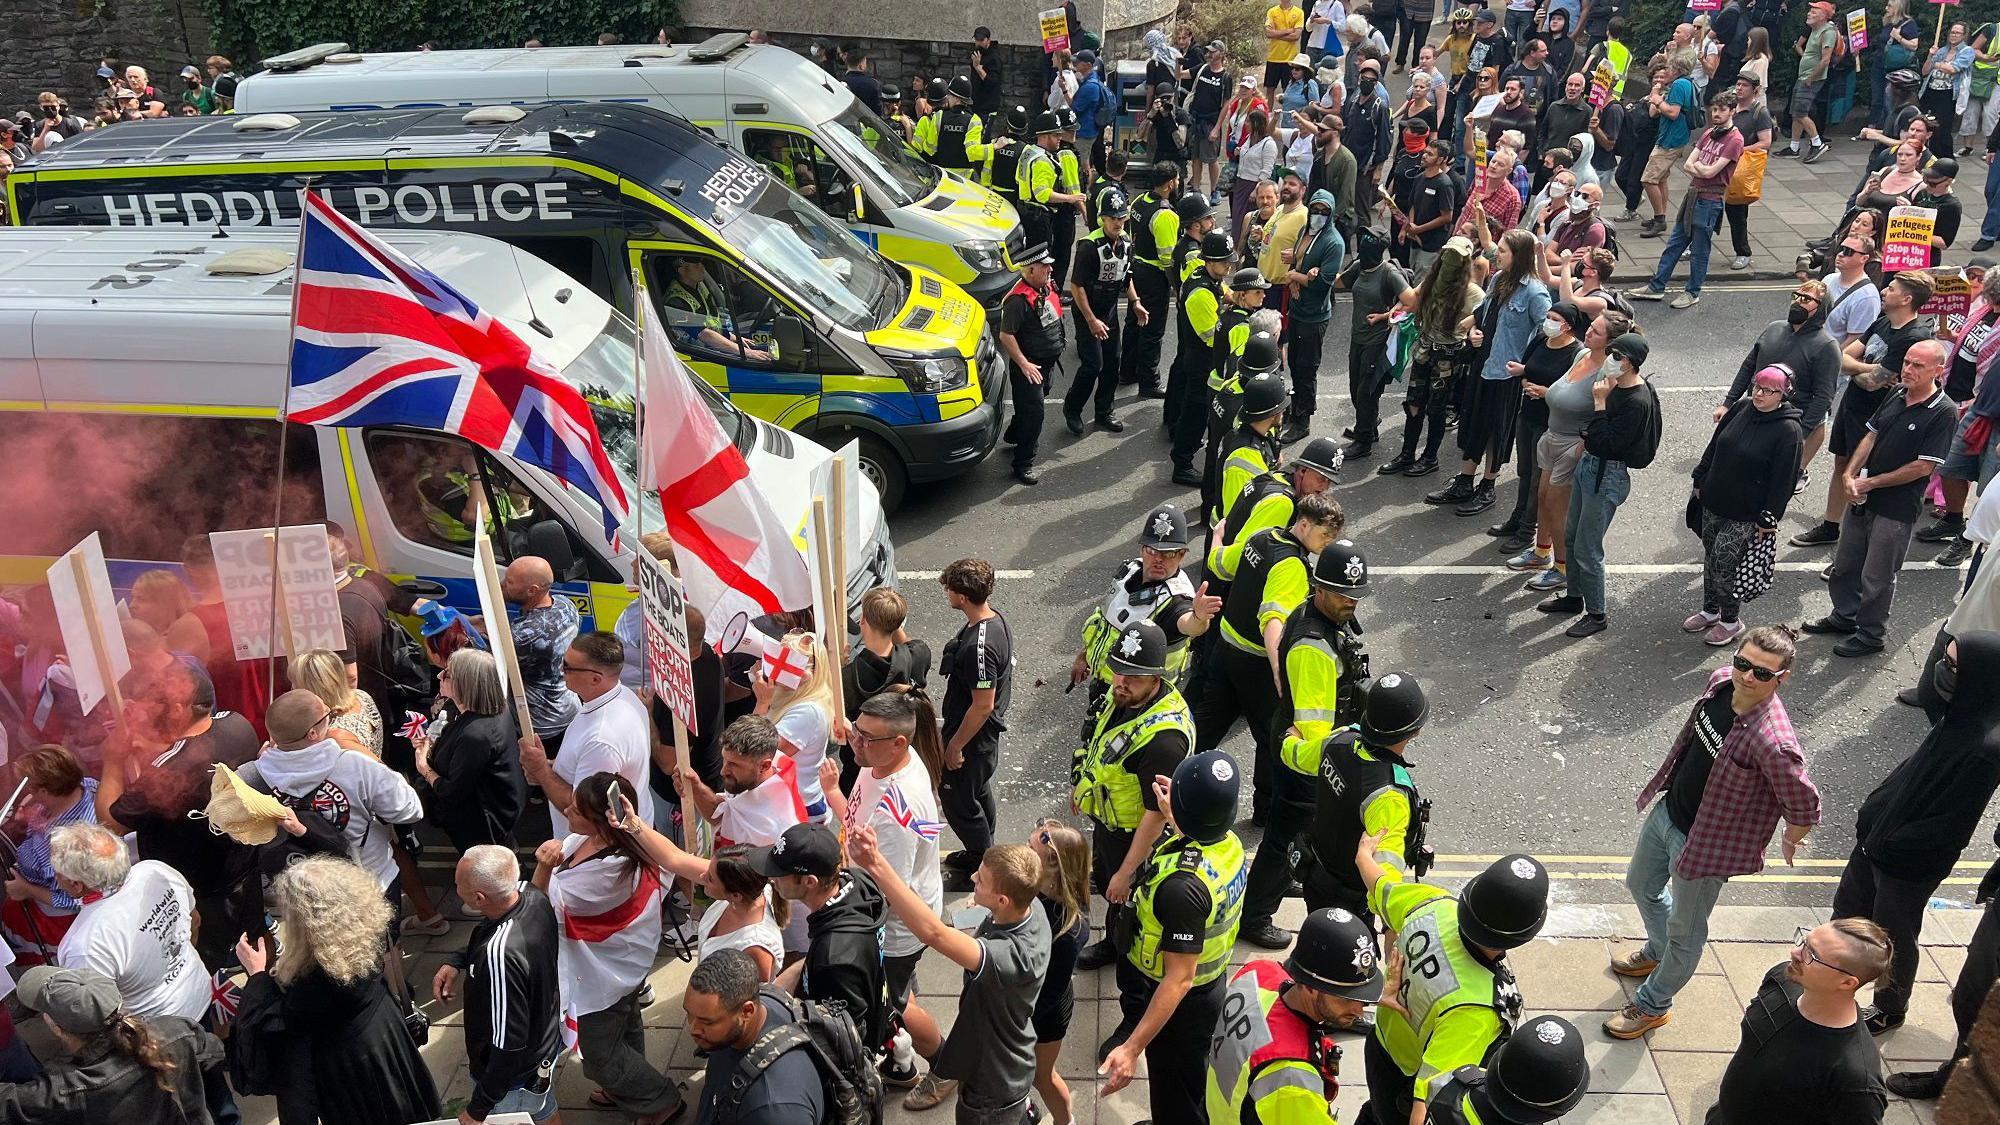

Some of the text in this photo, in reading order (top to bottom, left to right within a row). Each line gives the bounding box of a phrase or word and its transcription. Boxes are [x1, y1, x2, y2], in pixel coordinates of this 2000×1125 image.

[944, 124, 964, 133] POLICE
[698, 158, 748, 203] HEDDLU
[716, 167, 765, 214] POLICE
[354, 182, 574, 224] POLICE
[1889, 230, 1928, 242] welcome
[1890, 220, 1932, 232] Refugees
[1885, 255, 1924, 267] far right
[1887, 244, 1925, 255] Stop the
[1938, 302, 1965, 312] right
[639, 554, 683, 619] STOP
[643, 592, 687, 650] THE BOATS
[646, 622, 689, 677] DEPORT
[647, 643, 693, 700] ILLEGALS
[976, 680, 992, 689] NIKE
[653, 674, 691, 727] NOW
[1702, 715, 1724, 749] literally
[1320, 757, 1346, 797] POLICE
[139, 887, 175, 933] worldwide
[1172, 933, 1194, 941] POLICE
